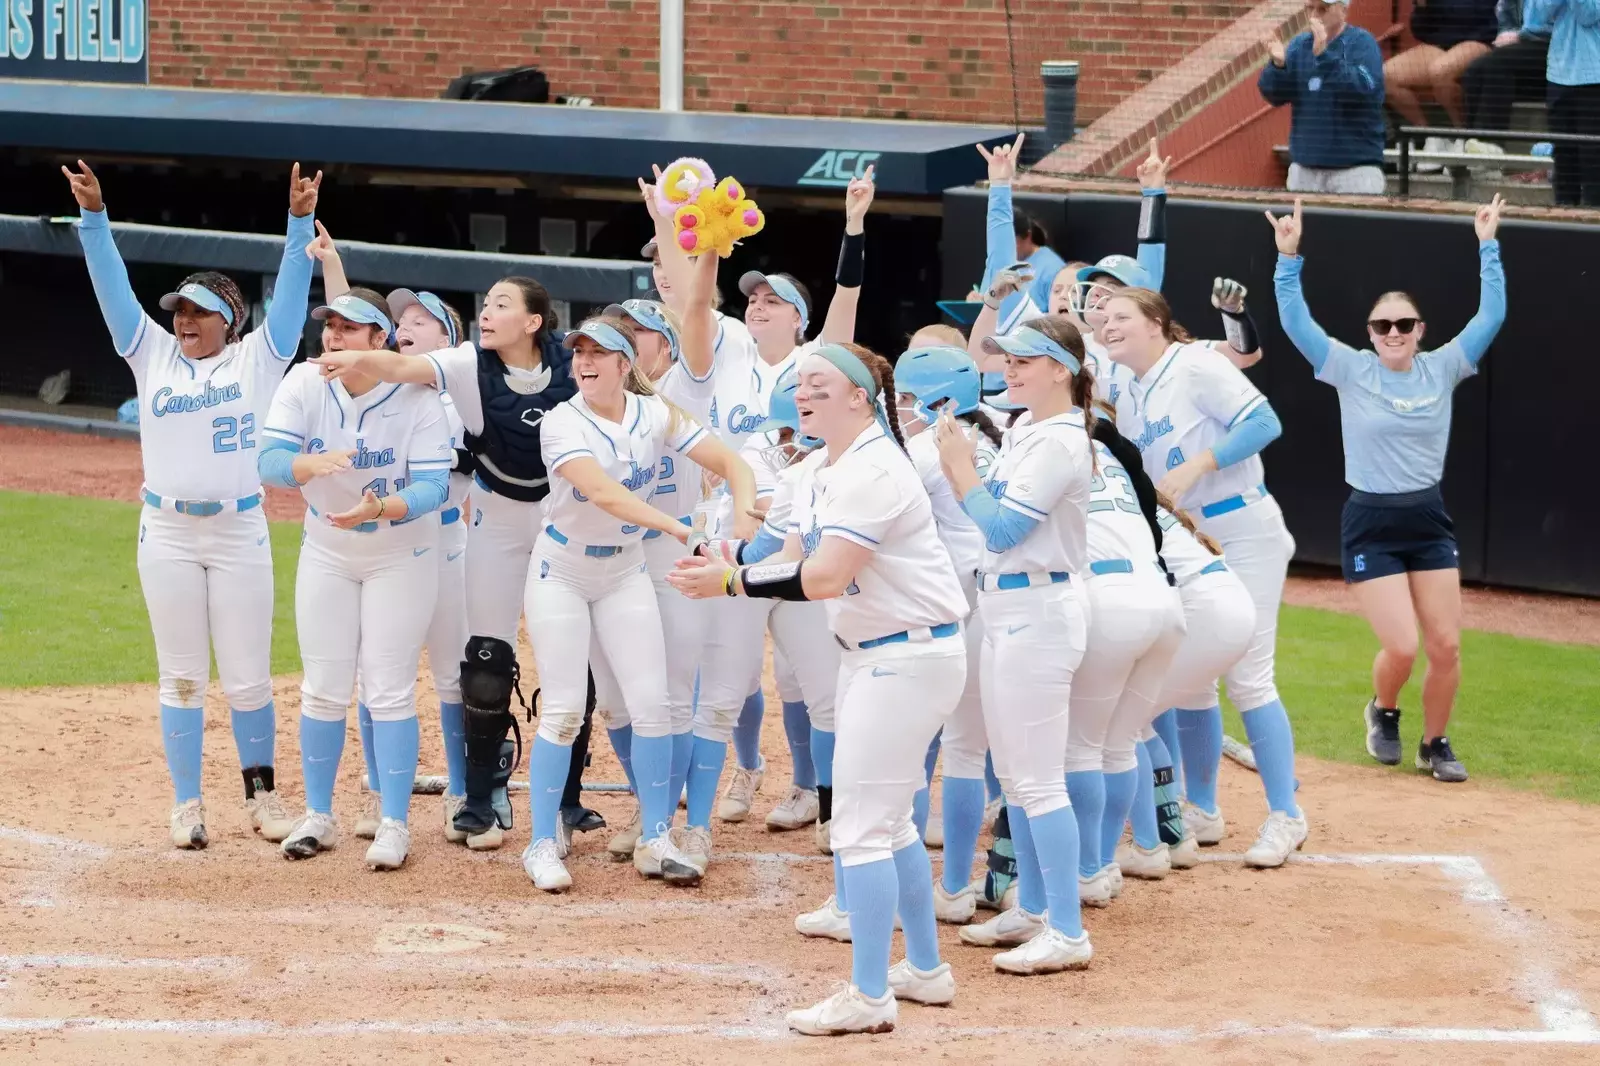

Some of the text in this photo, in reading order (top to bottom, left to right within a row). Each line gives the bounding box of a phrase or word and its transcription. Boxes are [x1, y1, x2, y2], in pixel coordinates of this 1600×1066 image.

[44, 0, 144, 63] FIELD
[803, 150, 881, 179] ACC
[152, 380, 242, 417] Carolina
[213, 412, 255, 453] 22
[307, 438, 395, 469] Clina
